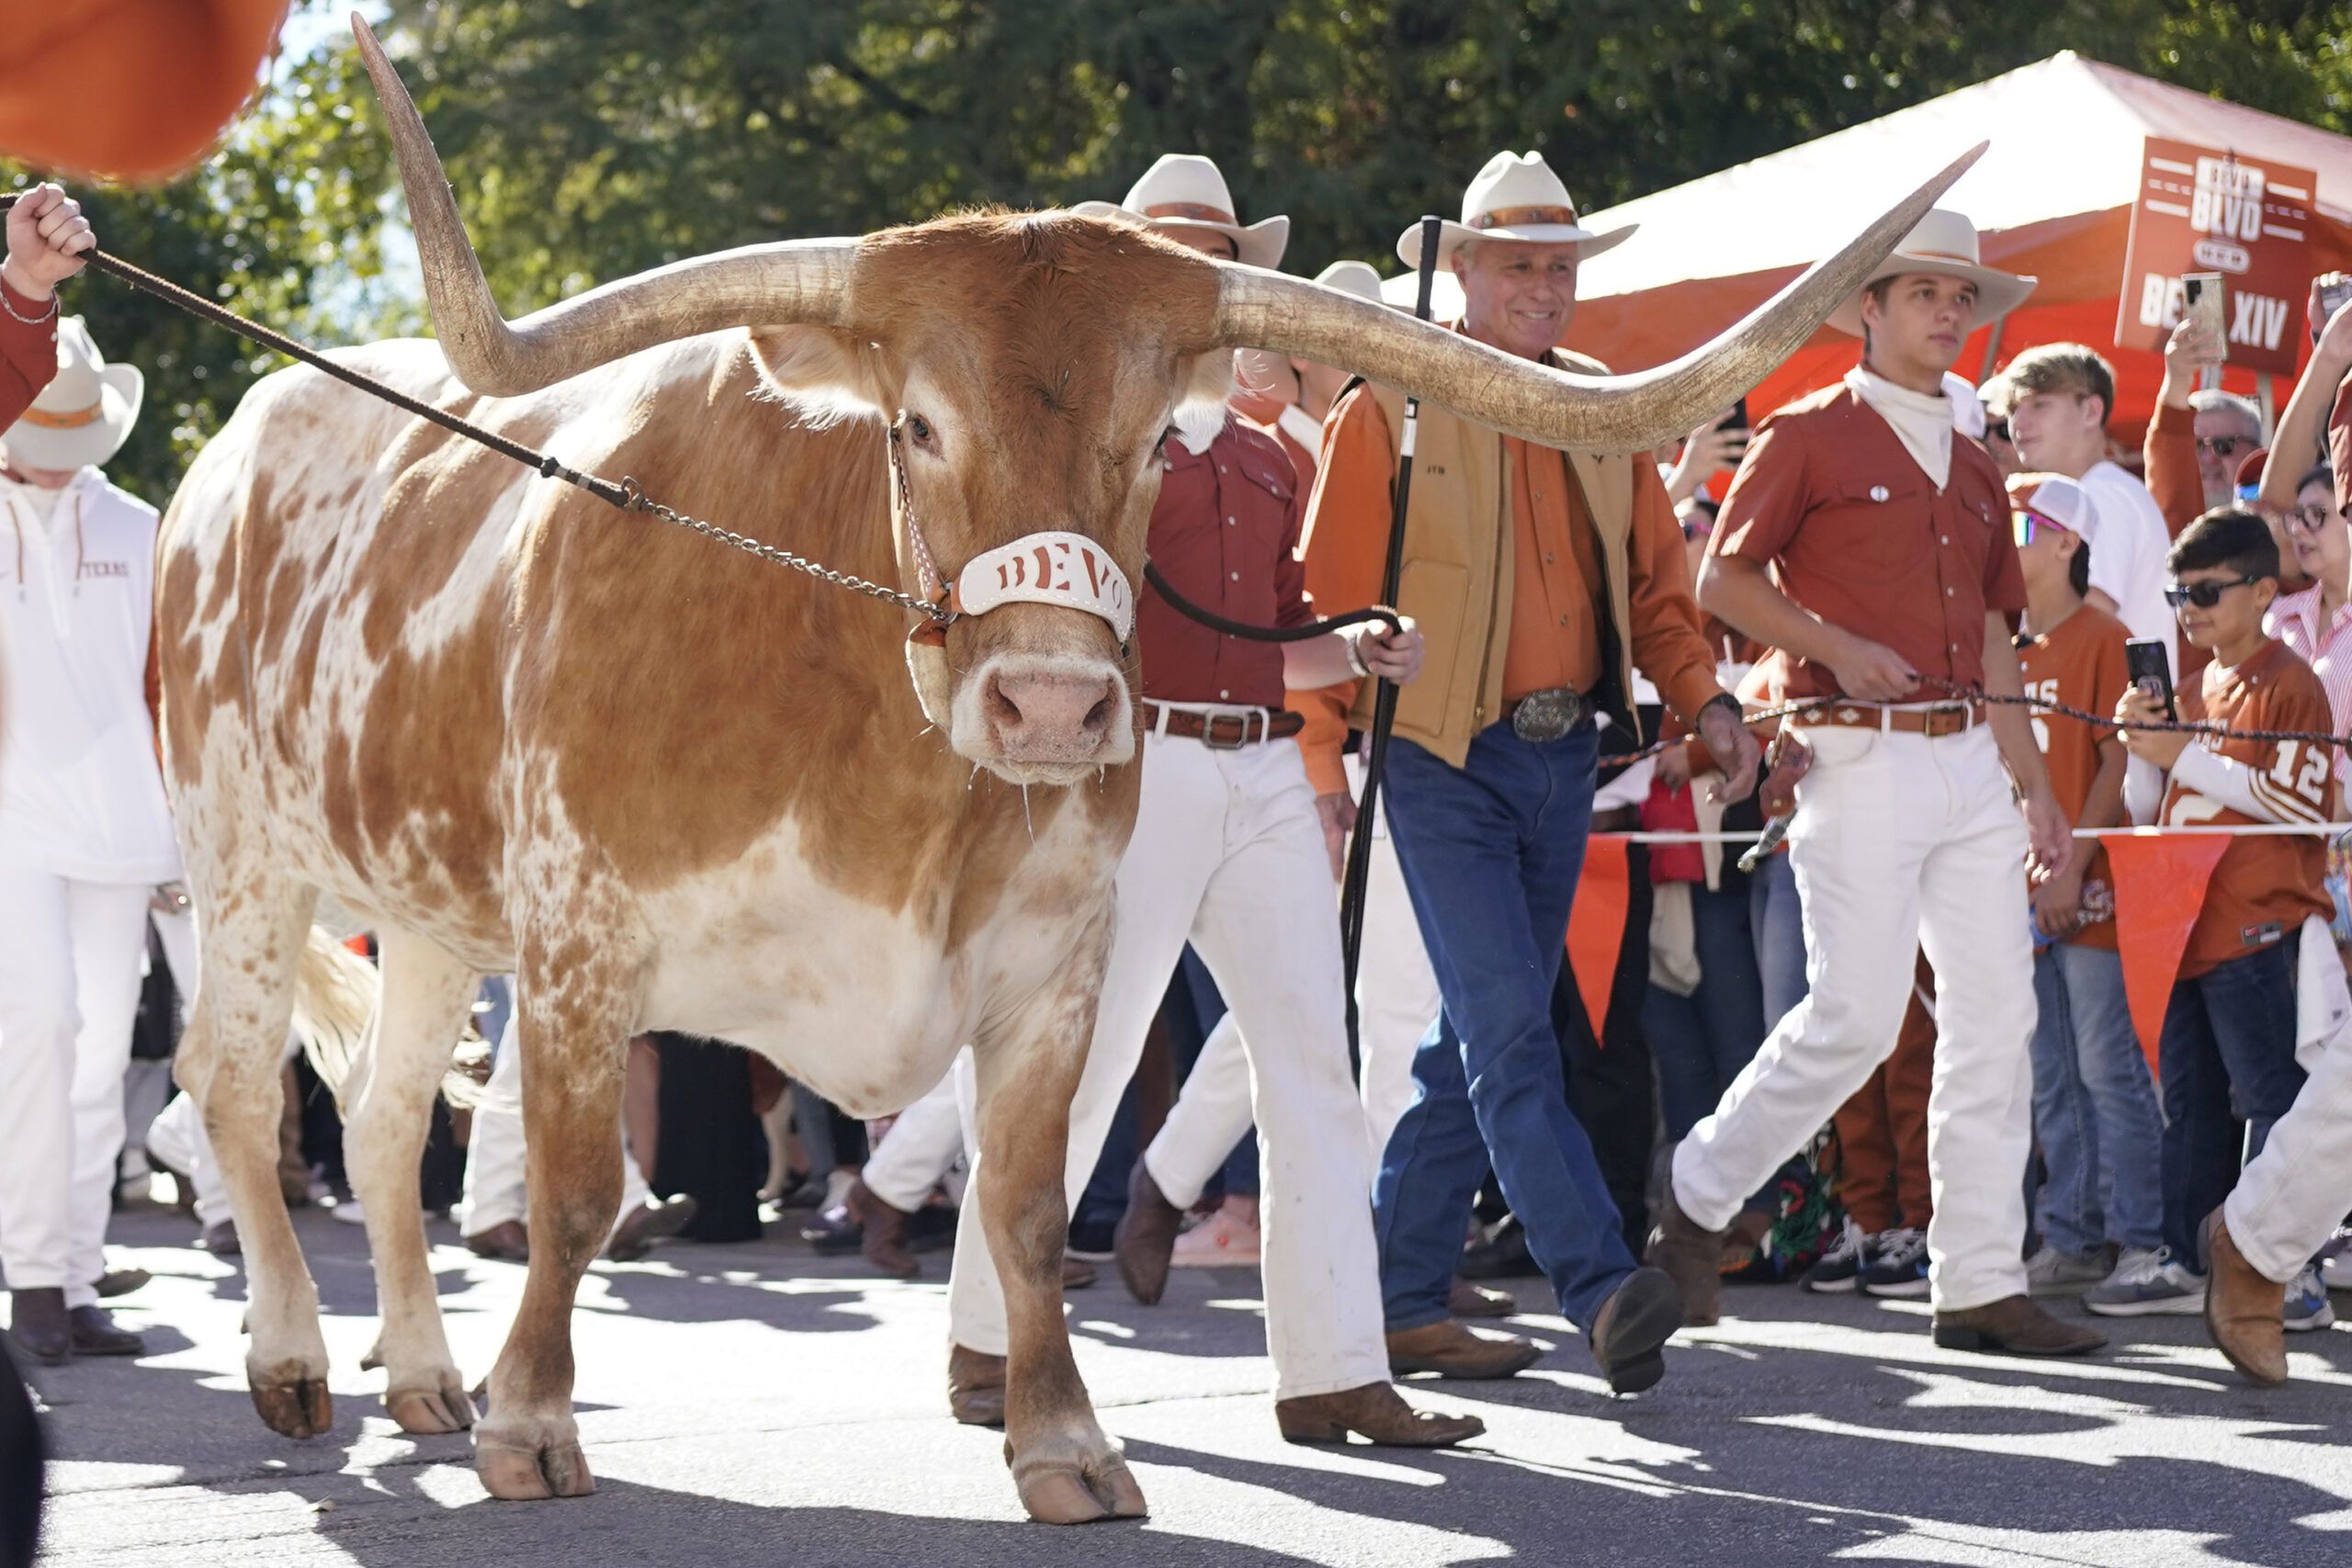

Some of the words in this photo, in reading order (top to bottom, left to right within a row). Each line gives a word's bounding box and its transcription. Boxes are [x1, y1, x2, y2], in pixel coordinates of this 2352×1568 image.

[2190, 187, 2262, 243] BLVD
[2228, 289, 2289, 351] XIV
[82, 559, 130, 578] TEXAS
[997, 543, 1123, 610] BEVO
[2269, 739, 2329, 807] 12
